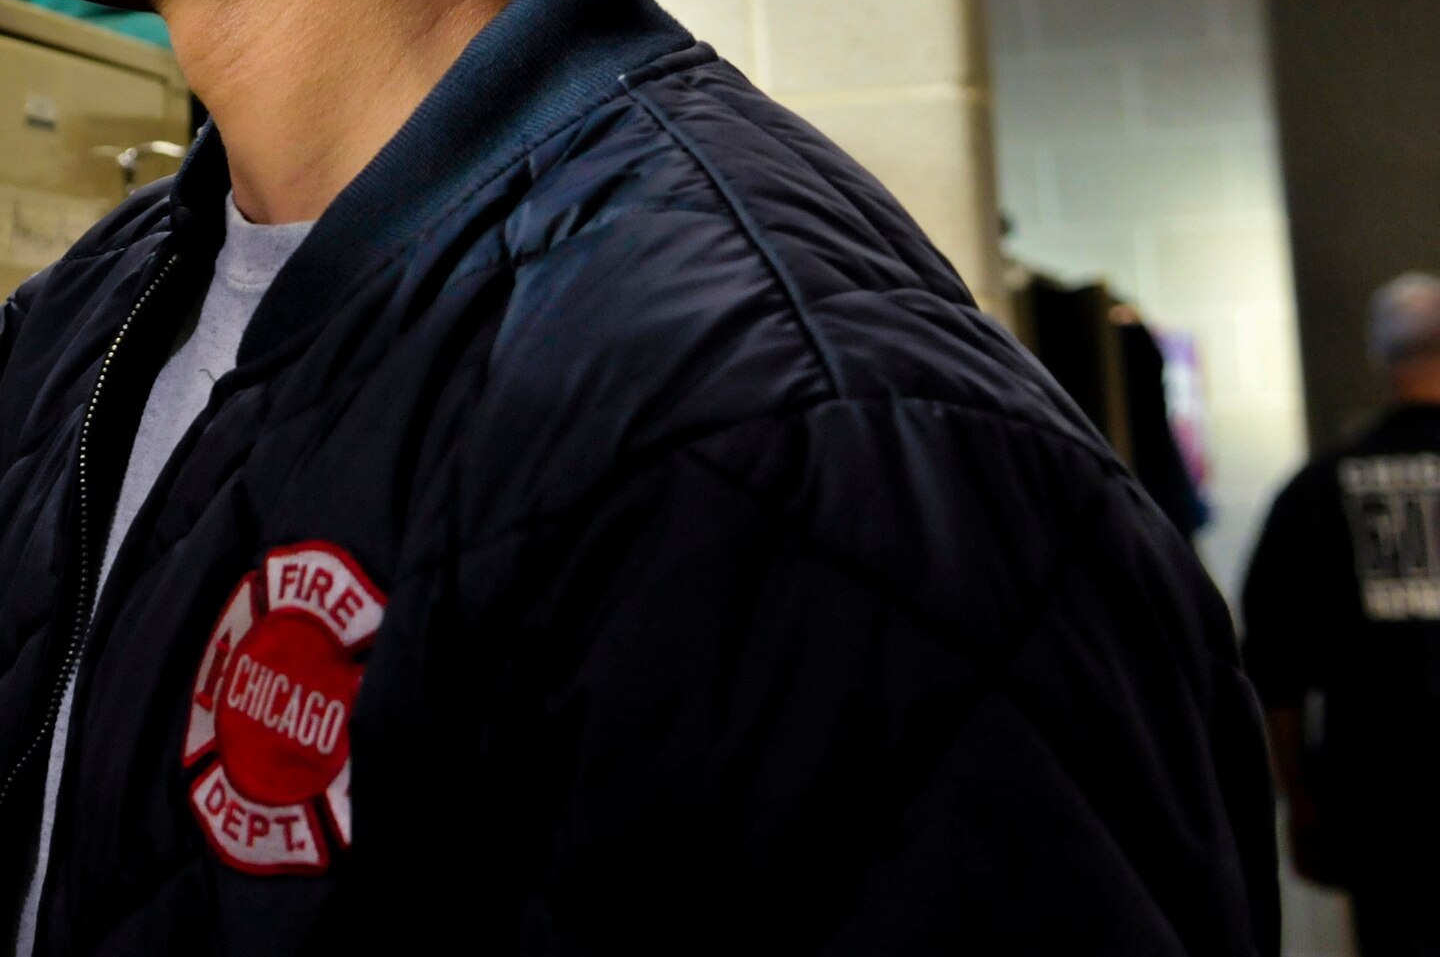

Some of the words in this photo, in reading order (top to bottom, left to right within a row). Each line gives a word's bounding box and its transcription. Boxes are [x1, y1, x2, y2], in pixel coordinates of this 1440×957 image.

[278, 562, 364, 632] FIRE
[227, 653, 346, 755] CHICAGO
[204, 778, 306, 852] DEPT.
